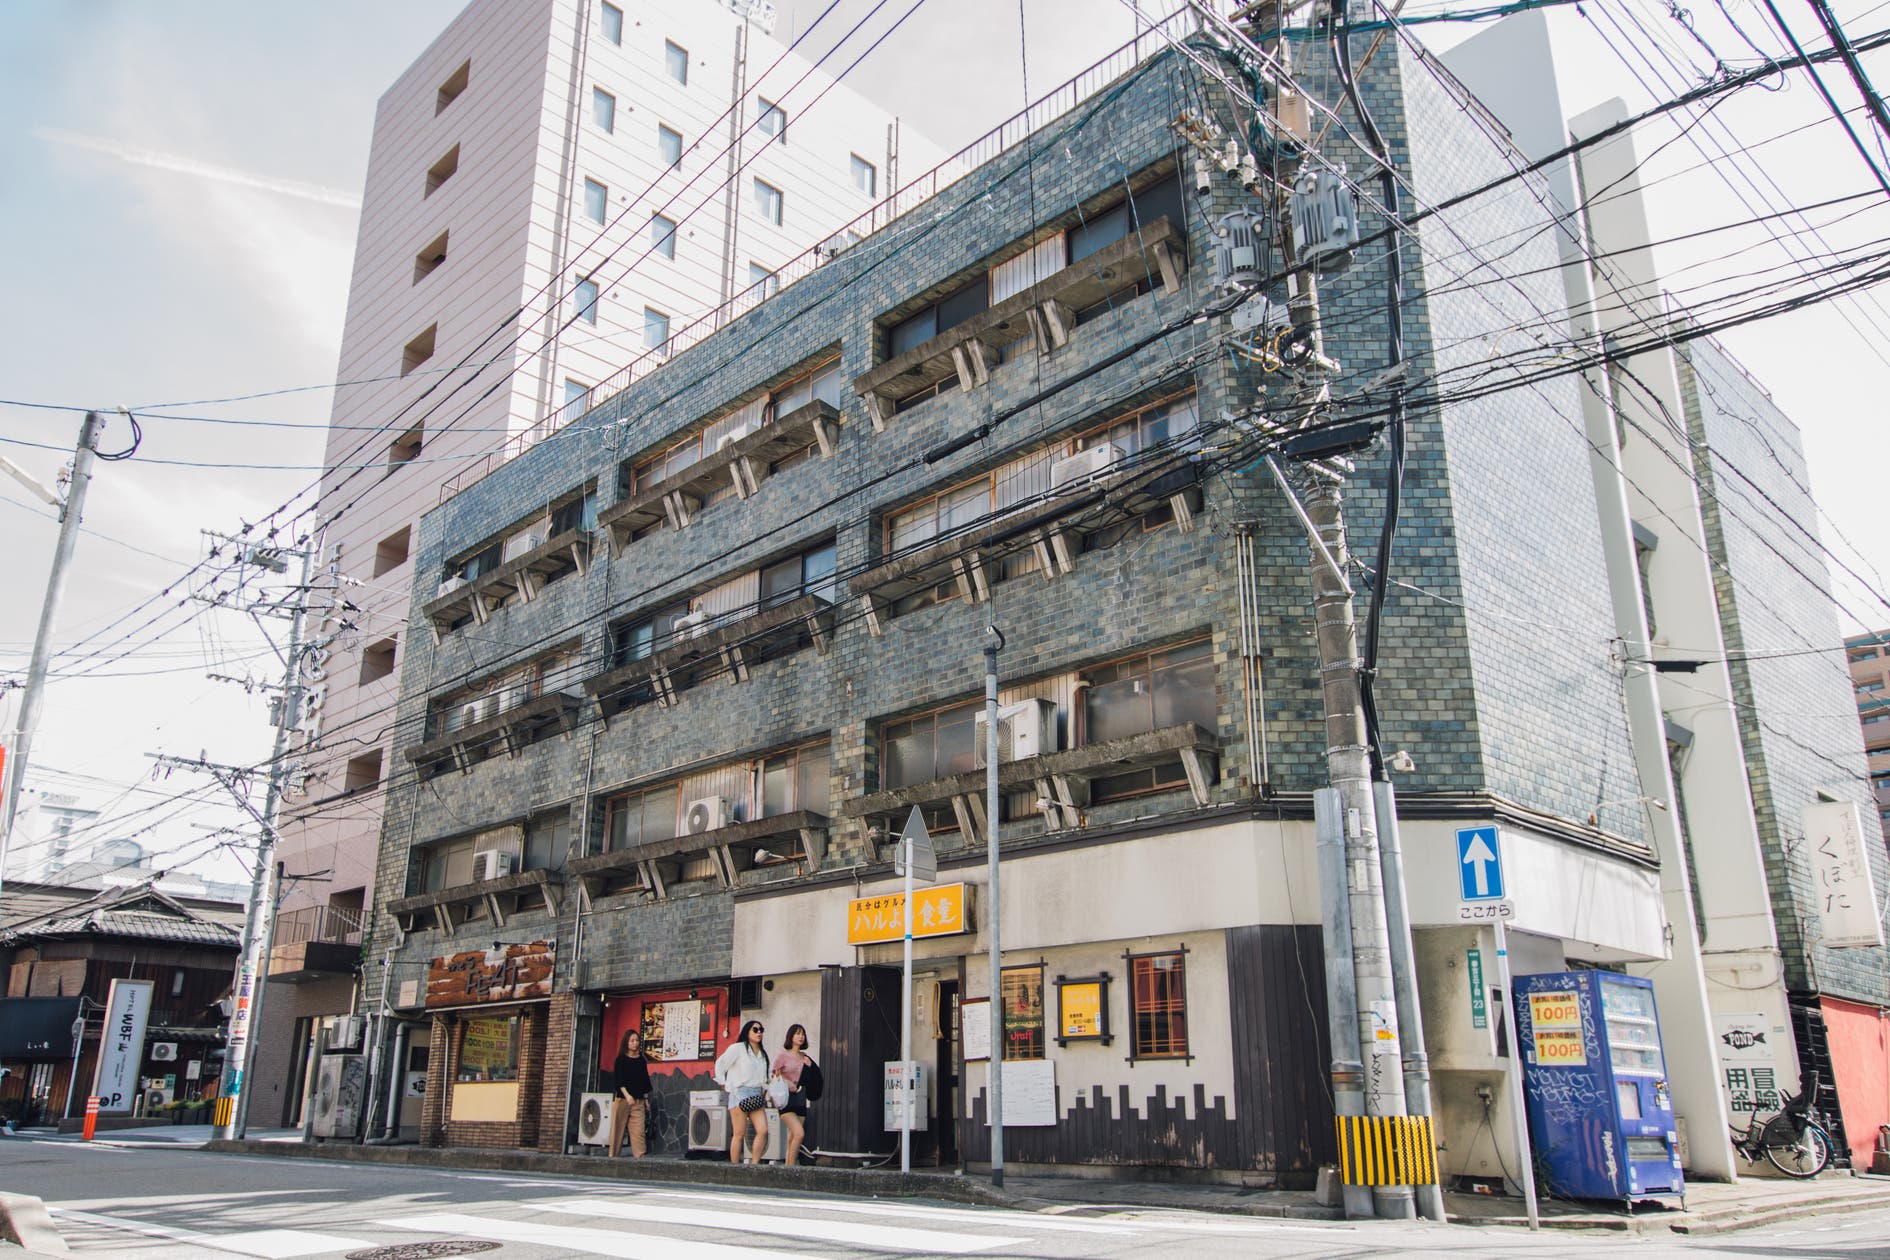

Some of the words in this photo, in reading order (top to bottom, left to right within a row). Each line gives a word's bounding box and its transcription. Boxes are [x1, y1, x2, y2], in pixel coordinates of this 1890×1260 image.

[1818, 835, 1851, 913] くぼた
[854, 898, 957, 931] ハルよ食堂
[1461, 904, 1511, 919] ここから
[1473, 999, 1484, 1009] 23
[1535, 1005, 1578, 1021] 100円
[119, 1013, 134, 1042] WBF
[1728, 1033, 1754, 1046] POND
[1539, 1043, 1583, 1057] 100円
[111, 1092, 122, 1107] P
